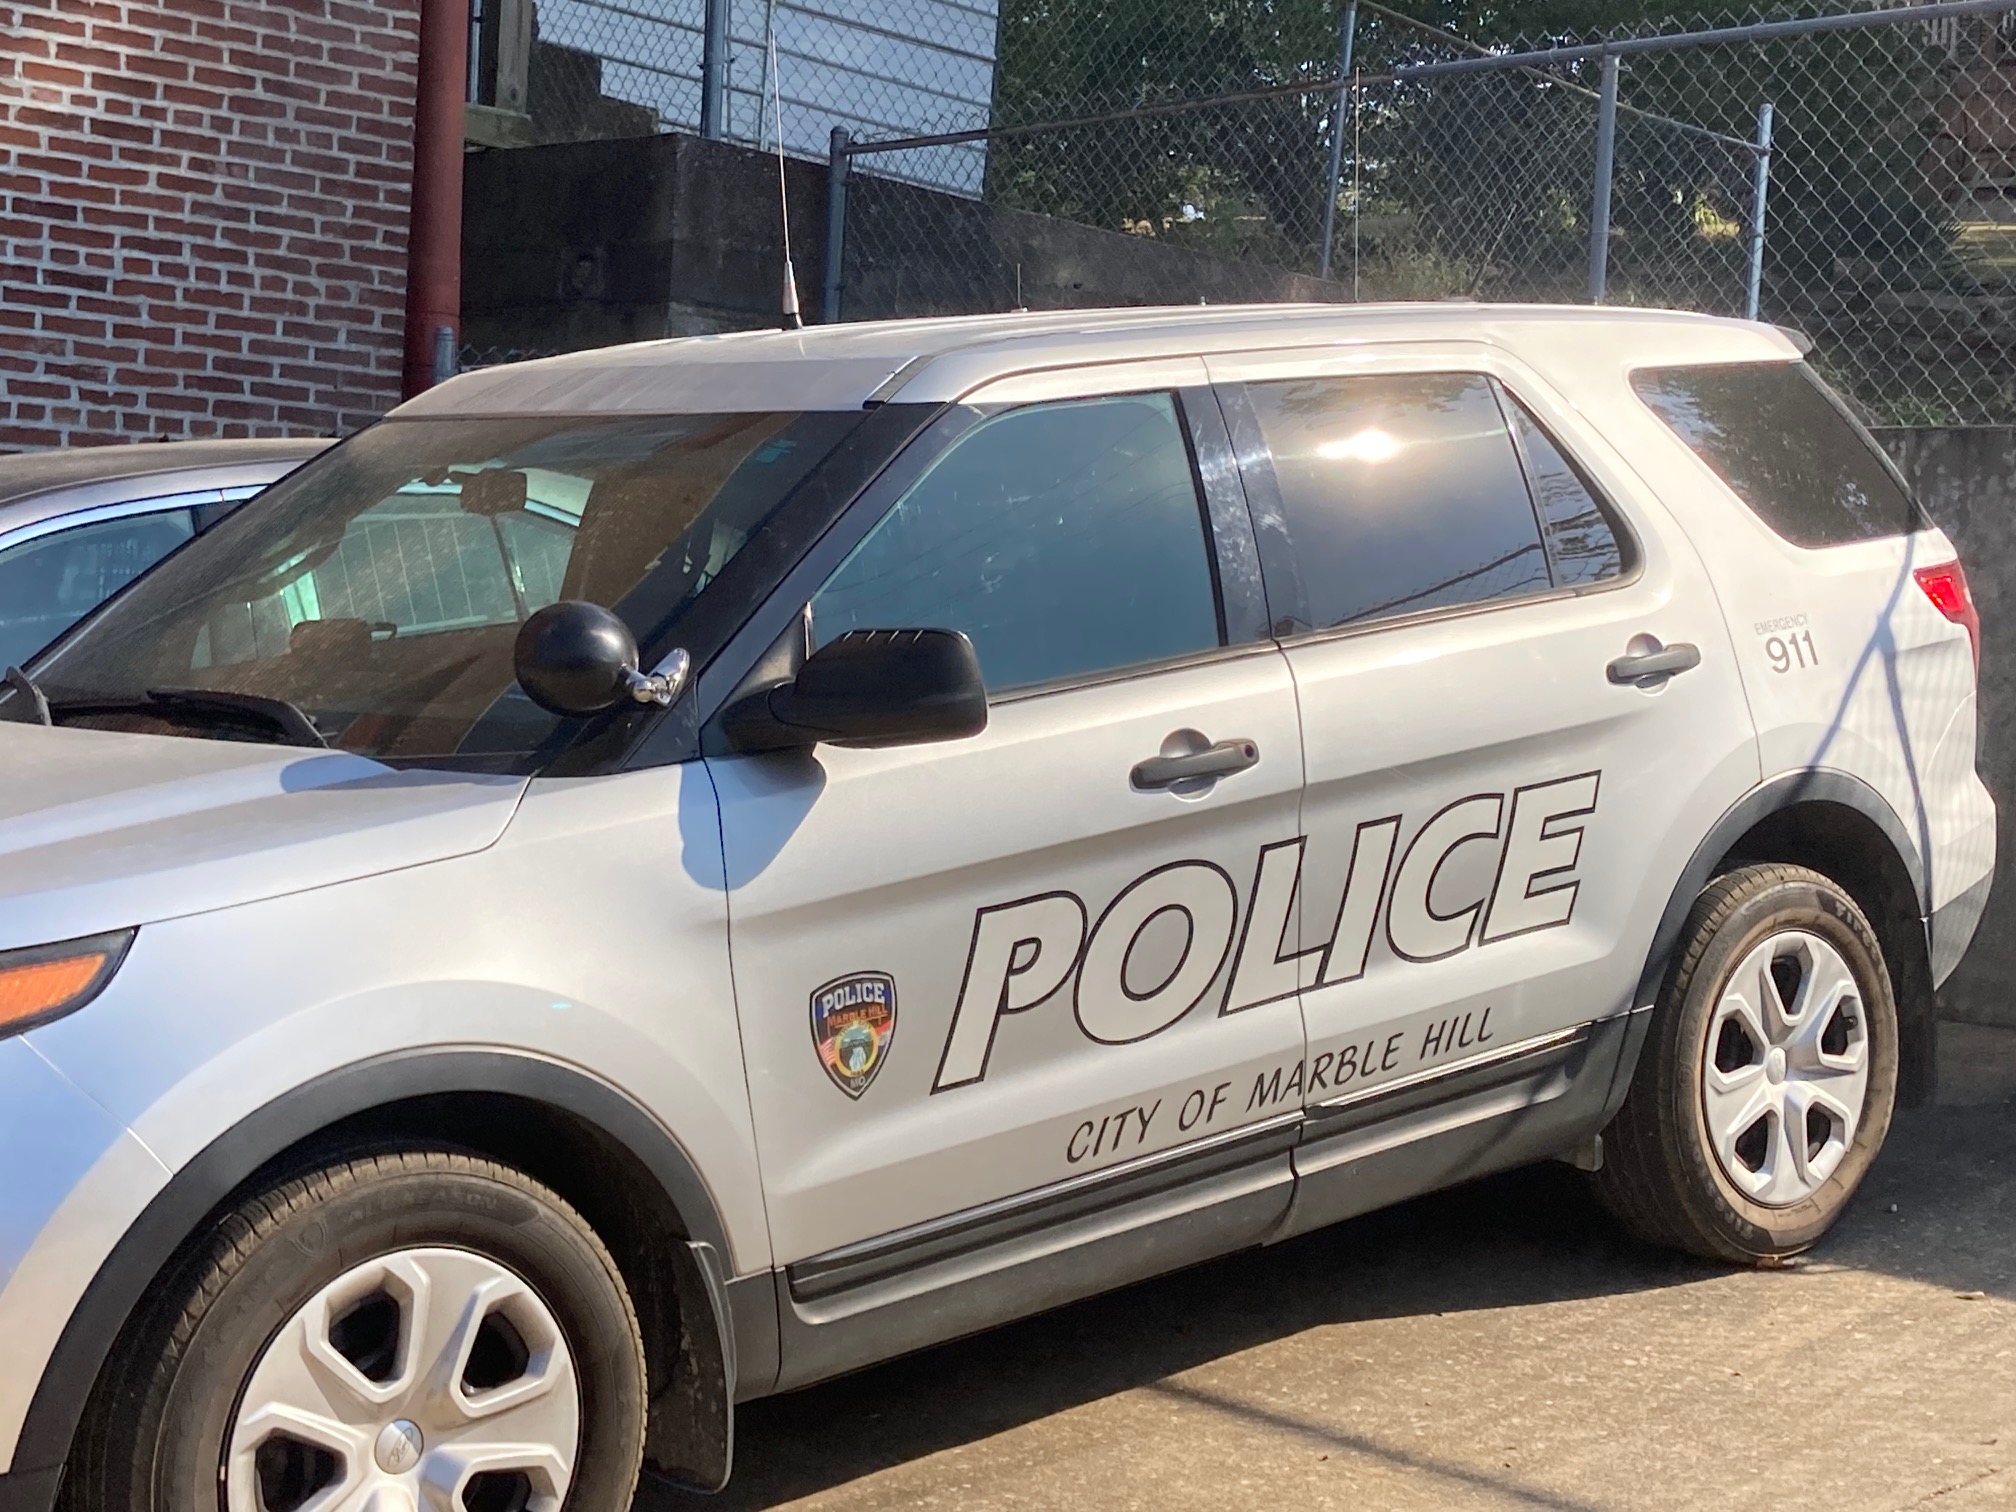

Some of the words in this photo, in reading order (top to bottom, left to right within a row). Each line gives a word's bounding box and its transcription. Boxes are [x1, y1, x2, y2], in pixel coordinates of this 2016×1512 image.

[1754, 612, 1808, 635] EMERGENCY
[1765, 630, 1819, 673] 911
[930, 770, 1602, 1095] POLICE
[822, 982, 885, 1018] POLICE
[827, 1008, 867, 1027] MARBLE
[868, 1003, 888, 1017] HILL
[1066, 1099, 1163, 1164] CITY
[1178, 1081, 1232, 1133] OF
[1245, 1032, 1404, 1113] MARBLE
[1419, 1007, 1493, 1061] HILL
